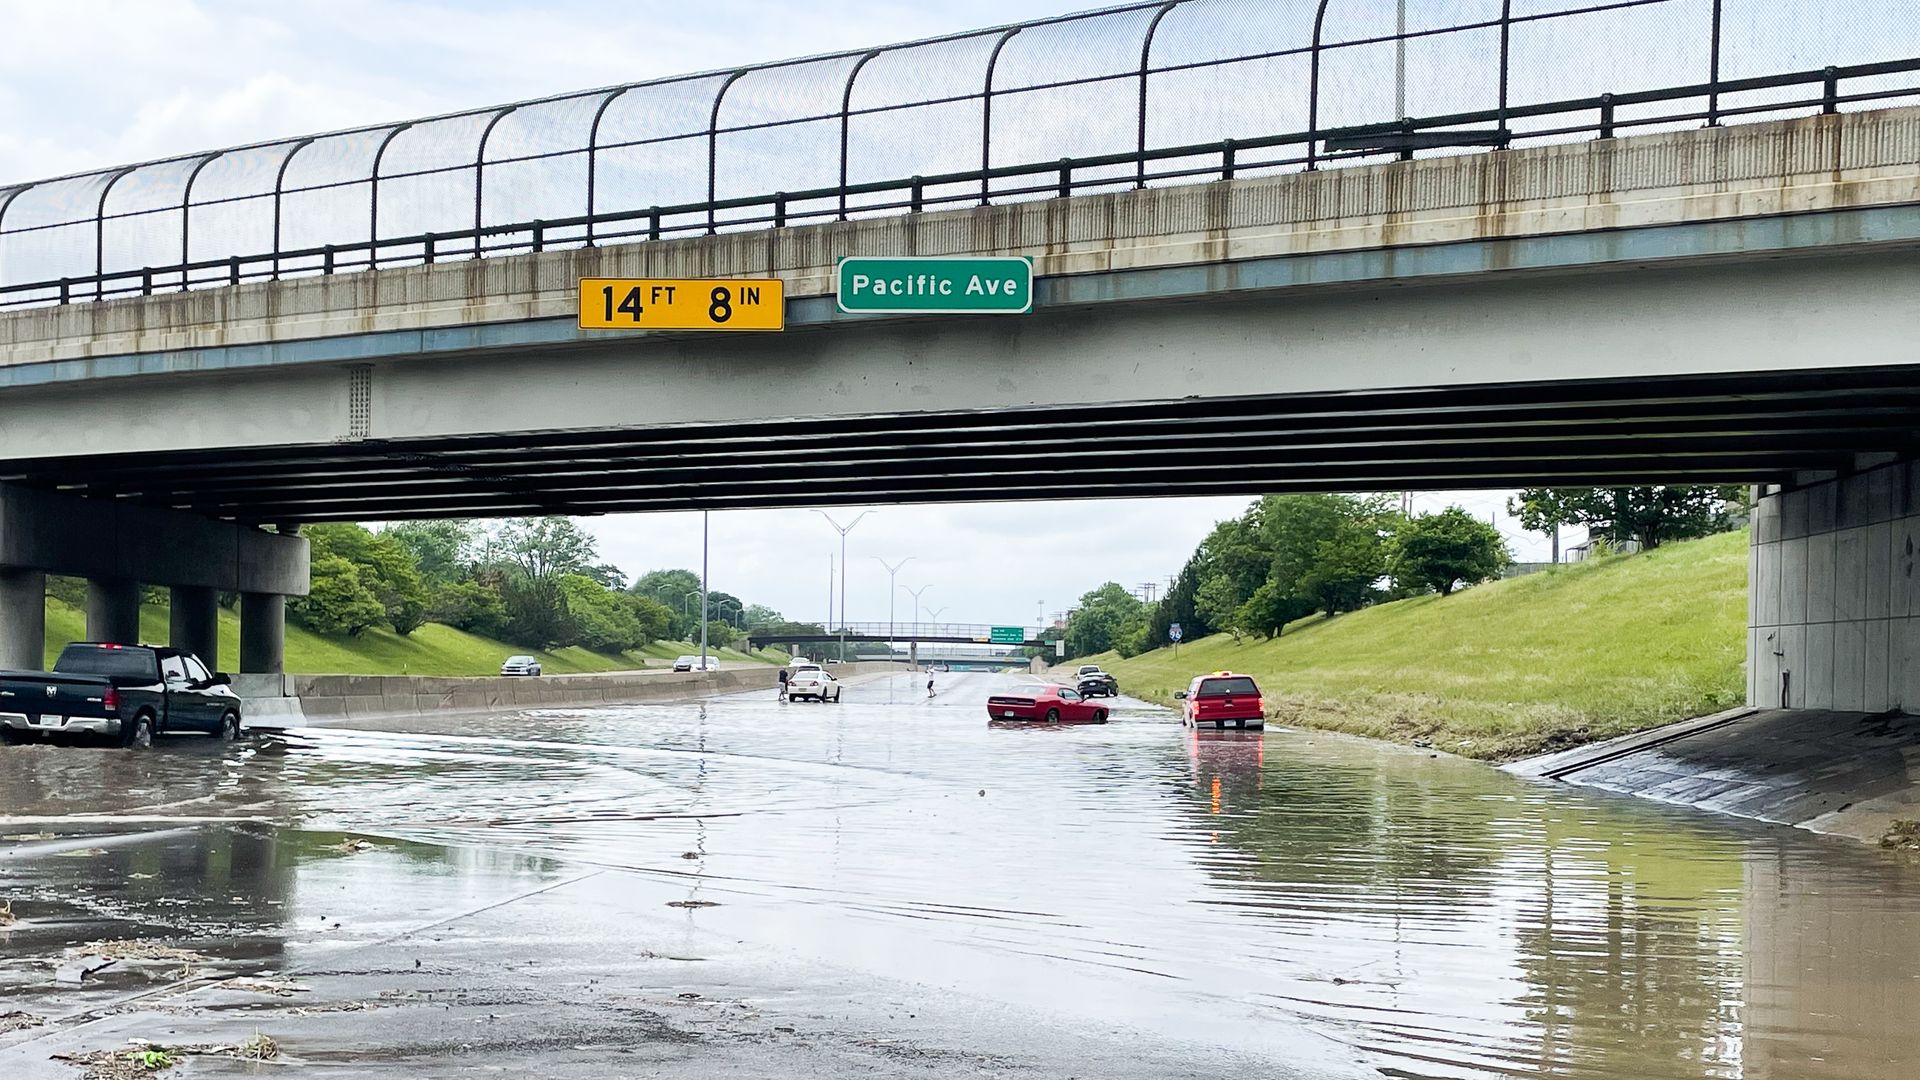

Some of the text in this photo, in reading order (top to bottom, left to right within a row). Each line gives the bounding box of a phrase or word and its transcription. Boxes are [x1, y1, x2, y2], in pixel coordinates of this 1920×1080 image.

[853, 274, 1018, 296] Pacific Ave
[603, 286, 760, 323] 14 FT 8 IN
[1170, 630, 1181, 639] 96
